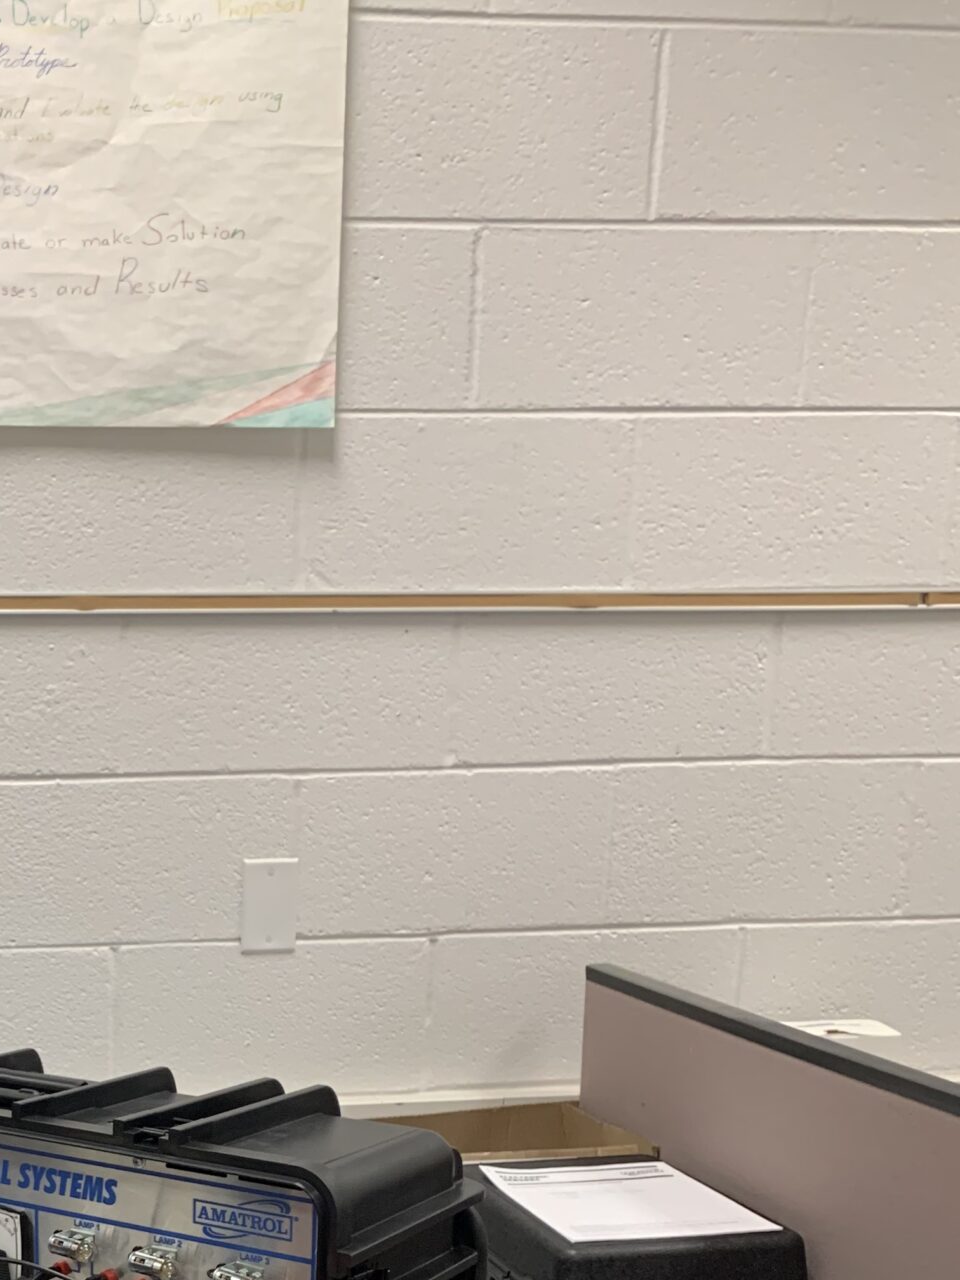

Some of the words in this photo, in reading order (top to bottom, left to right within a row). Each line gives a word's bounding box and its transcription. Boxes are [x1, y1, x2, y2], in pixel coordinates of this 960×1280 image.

[138, 0, 203, 33] Design
[238, 91, 285, 114] using
[45, 238, 68, 250] or
[81, 228, 134, 248] make
[55, 274, 100, 298] and
[114, 256, 210, 297] Results
[17, 1164, 118, 1206] SYSTEMS
[73, 1219, 93, 1230] LAMP
[153, 1235, 175, 1246] LAMP
